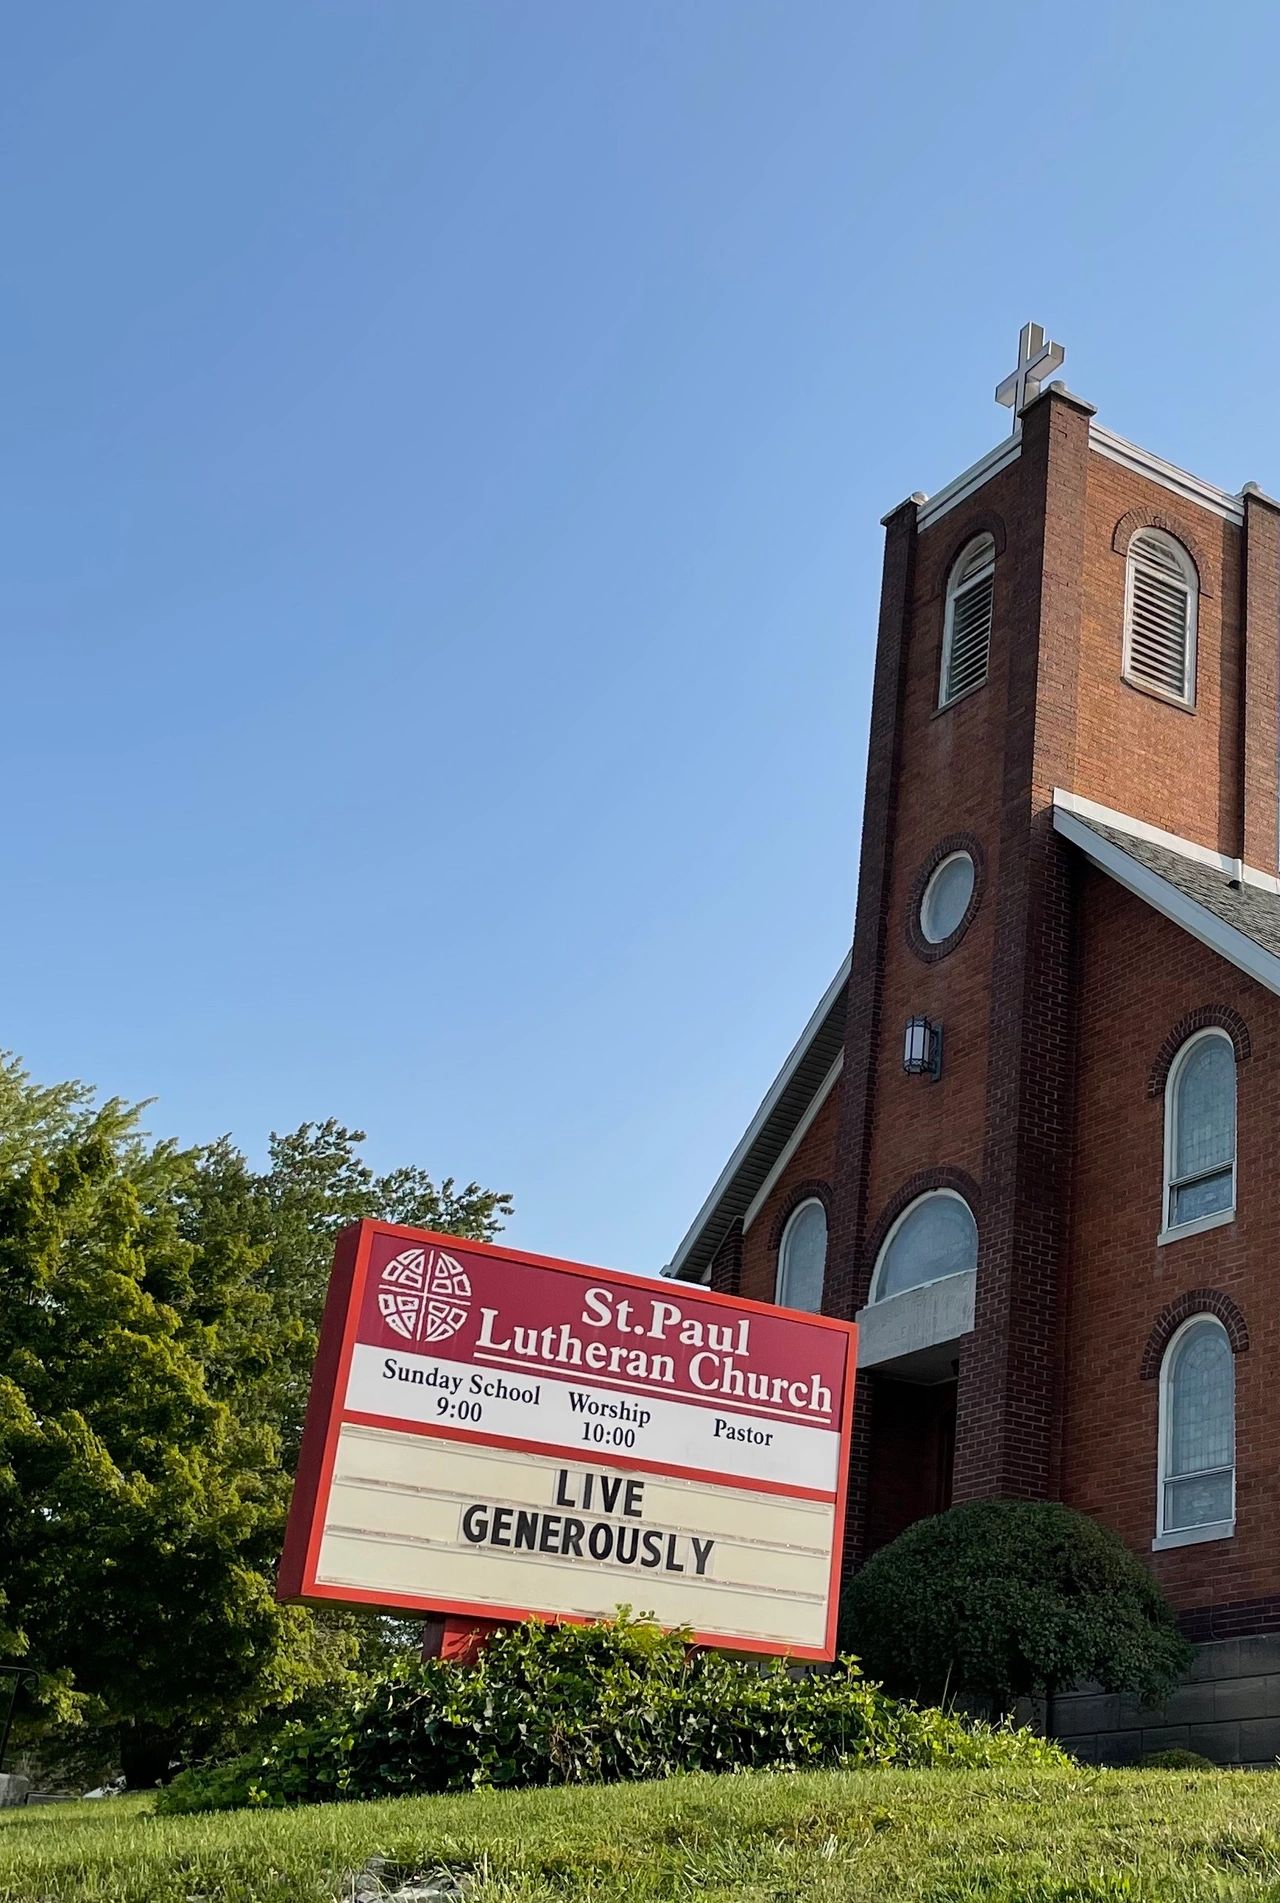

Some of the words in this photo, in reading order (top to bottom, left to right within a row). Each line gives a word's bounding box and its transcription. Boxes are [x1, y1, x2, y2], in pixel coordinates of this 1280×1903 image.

[475, 1308, 676, 1384] Lutheran
[689, 1351, 833, 1413] Church
[382, 1359, 464, 1402] Sunday
[469, 1374, 541, 1405] School
[436, 1398, 483, 1423] 9:00
[568, 1391, 652, 1427] Worship
[581, 1421, 636, 1449] 10:00
[713, 1418, 774, 1447] Pastor
[556, 1469, 645, 1518] LIVE
[463, 1505, 716, 1575] GENEROUSLY
